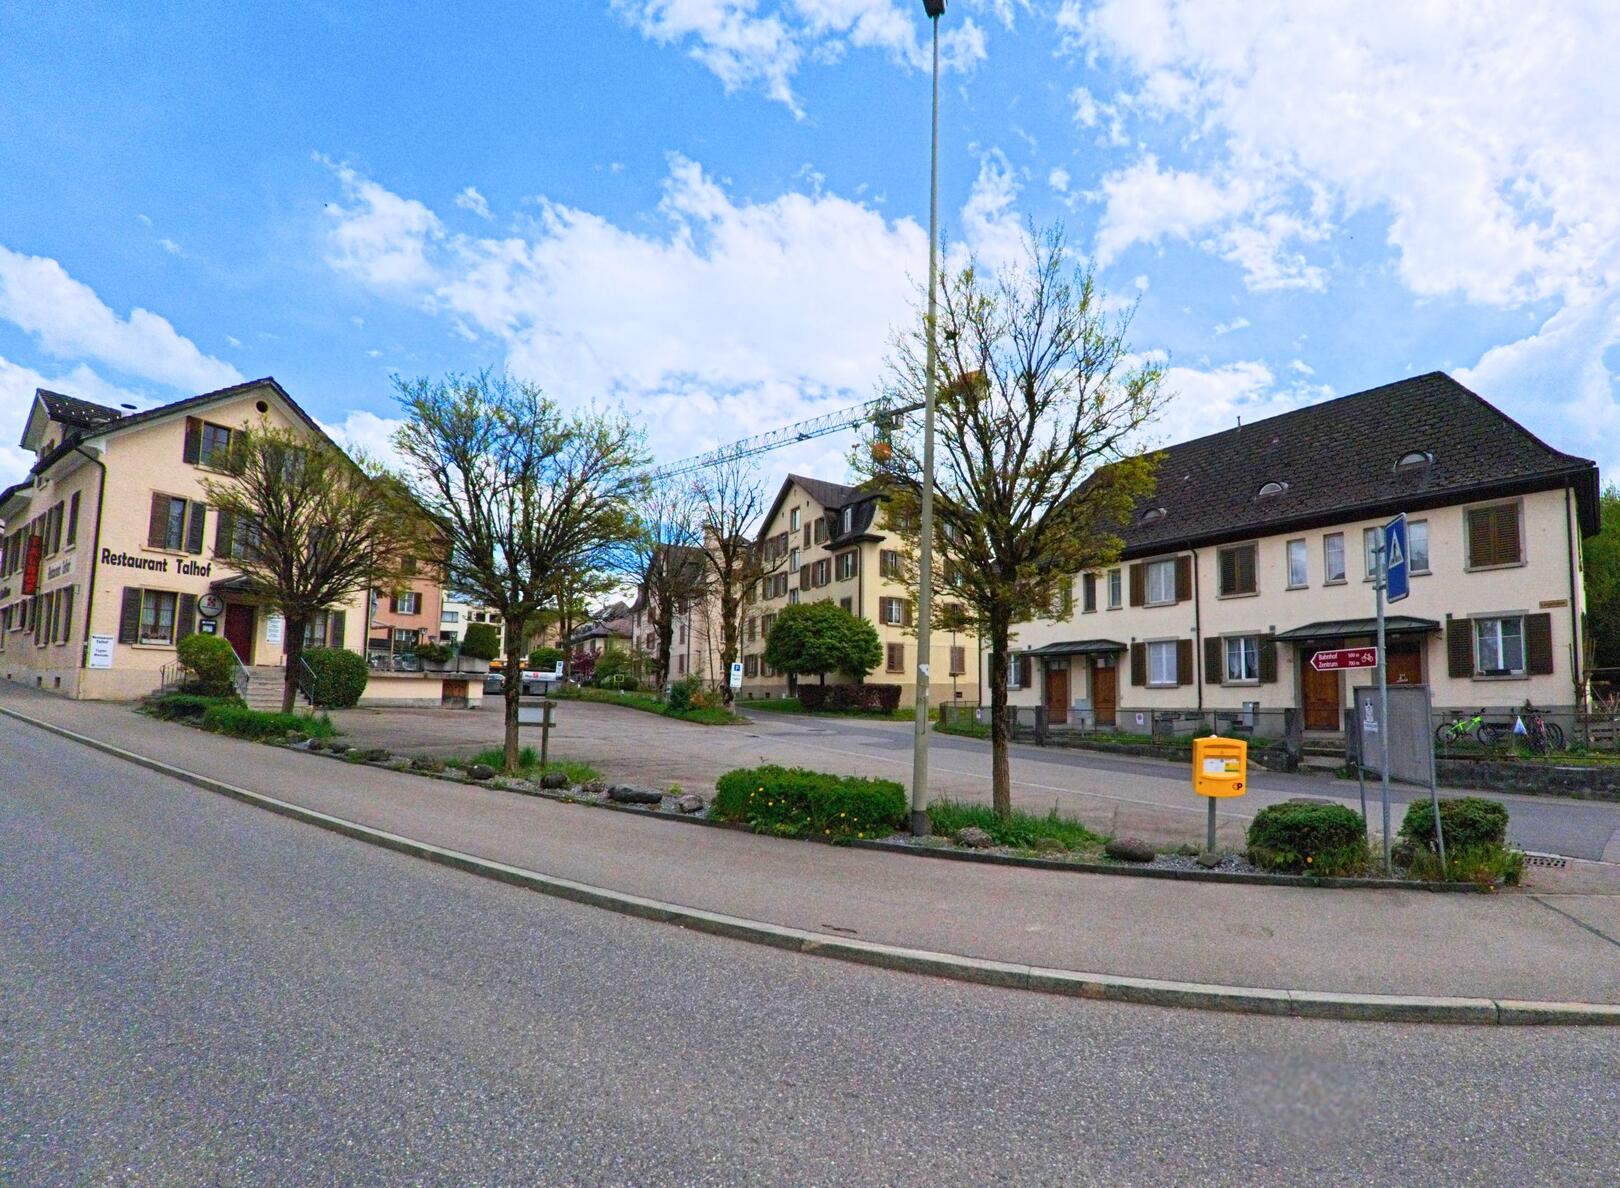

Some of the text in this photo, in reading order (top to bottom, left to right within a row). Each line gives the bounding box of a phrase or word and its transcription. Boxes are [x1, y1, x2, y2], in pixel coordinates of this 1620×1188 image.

[101, 548, 212, 577] Restaurant Talhof
[1318, 652, 1338, 660] Bahnhof
